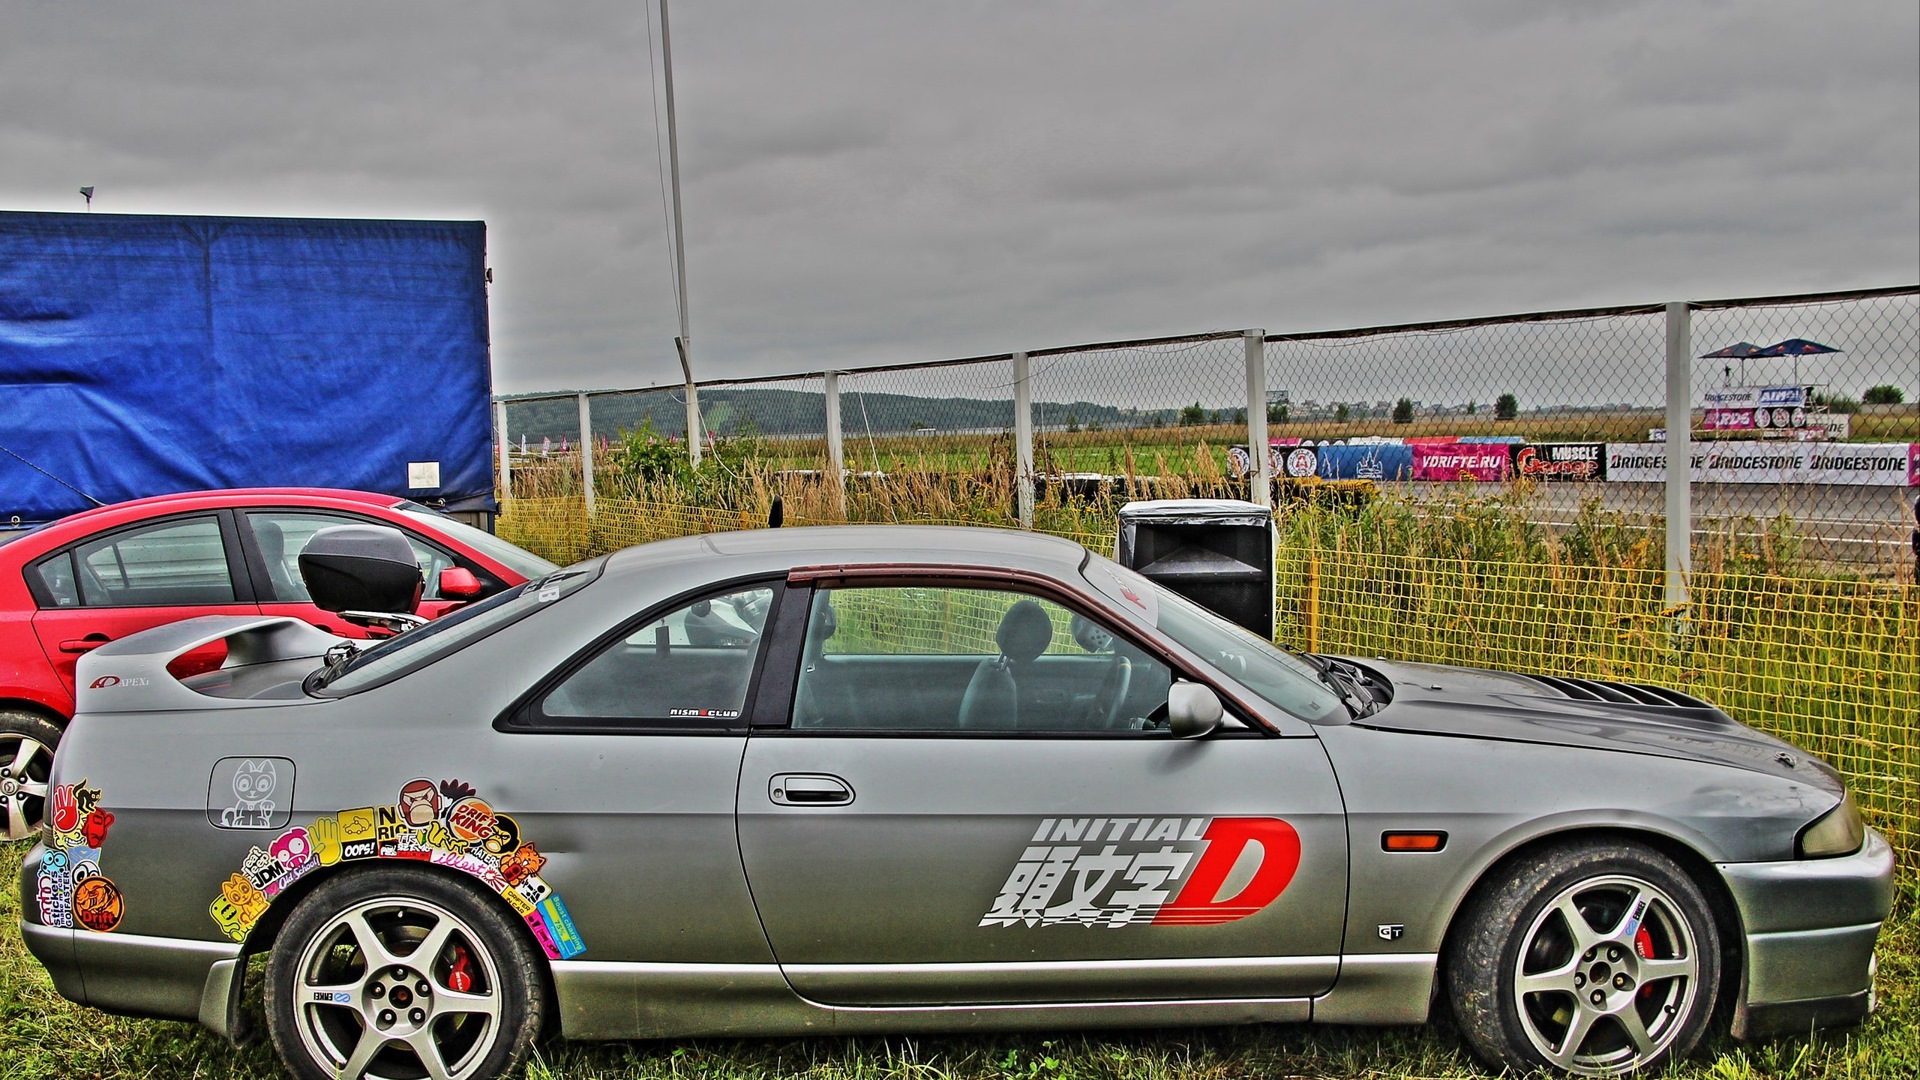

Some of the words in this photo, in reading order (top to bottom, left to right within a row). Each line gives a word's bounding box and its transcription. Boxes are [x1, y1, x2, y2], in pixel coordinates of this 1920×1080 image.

[1422, 455, 1501, 469] VDRIFTE.RU
[1551, 446, 1599, 460] MUSCLE
[1709, 455, 1803, 470] BRIDGESTONE
[1810, 455, 1907, 471] BRIDGESTONE
[450, 812, 493, 839] KING
[457, 804, 498, 827] DRIFT
[245, 848, 262, 868] eat
[344, 842, 375, 858] OOPS!
[470, 846, 500, 867] HATERS
[433, 851, 486, 875] illest
[1031, 818, 1204, 841] INITIAL
[1149, 816, 1302, 927] D
[252, 860, 286, 888] JDM
[279, 874, 294, 890] Old
[50, 870, 61, 926] stickers
[63, 871, 71, 910] FASTER
[507, 890, 531, 912] DRIFTER
[511, 902, 525, 914] CAR
[65, 912, 73, 927] GO
[82, 910, 114, 924] Drift
[553, 896, 567, 918] Boost
[564, 919, 583, 951] charging
[1380, 927, 1402, 937] GT
